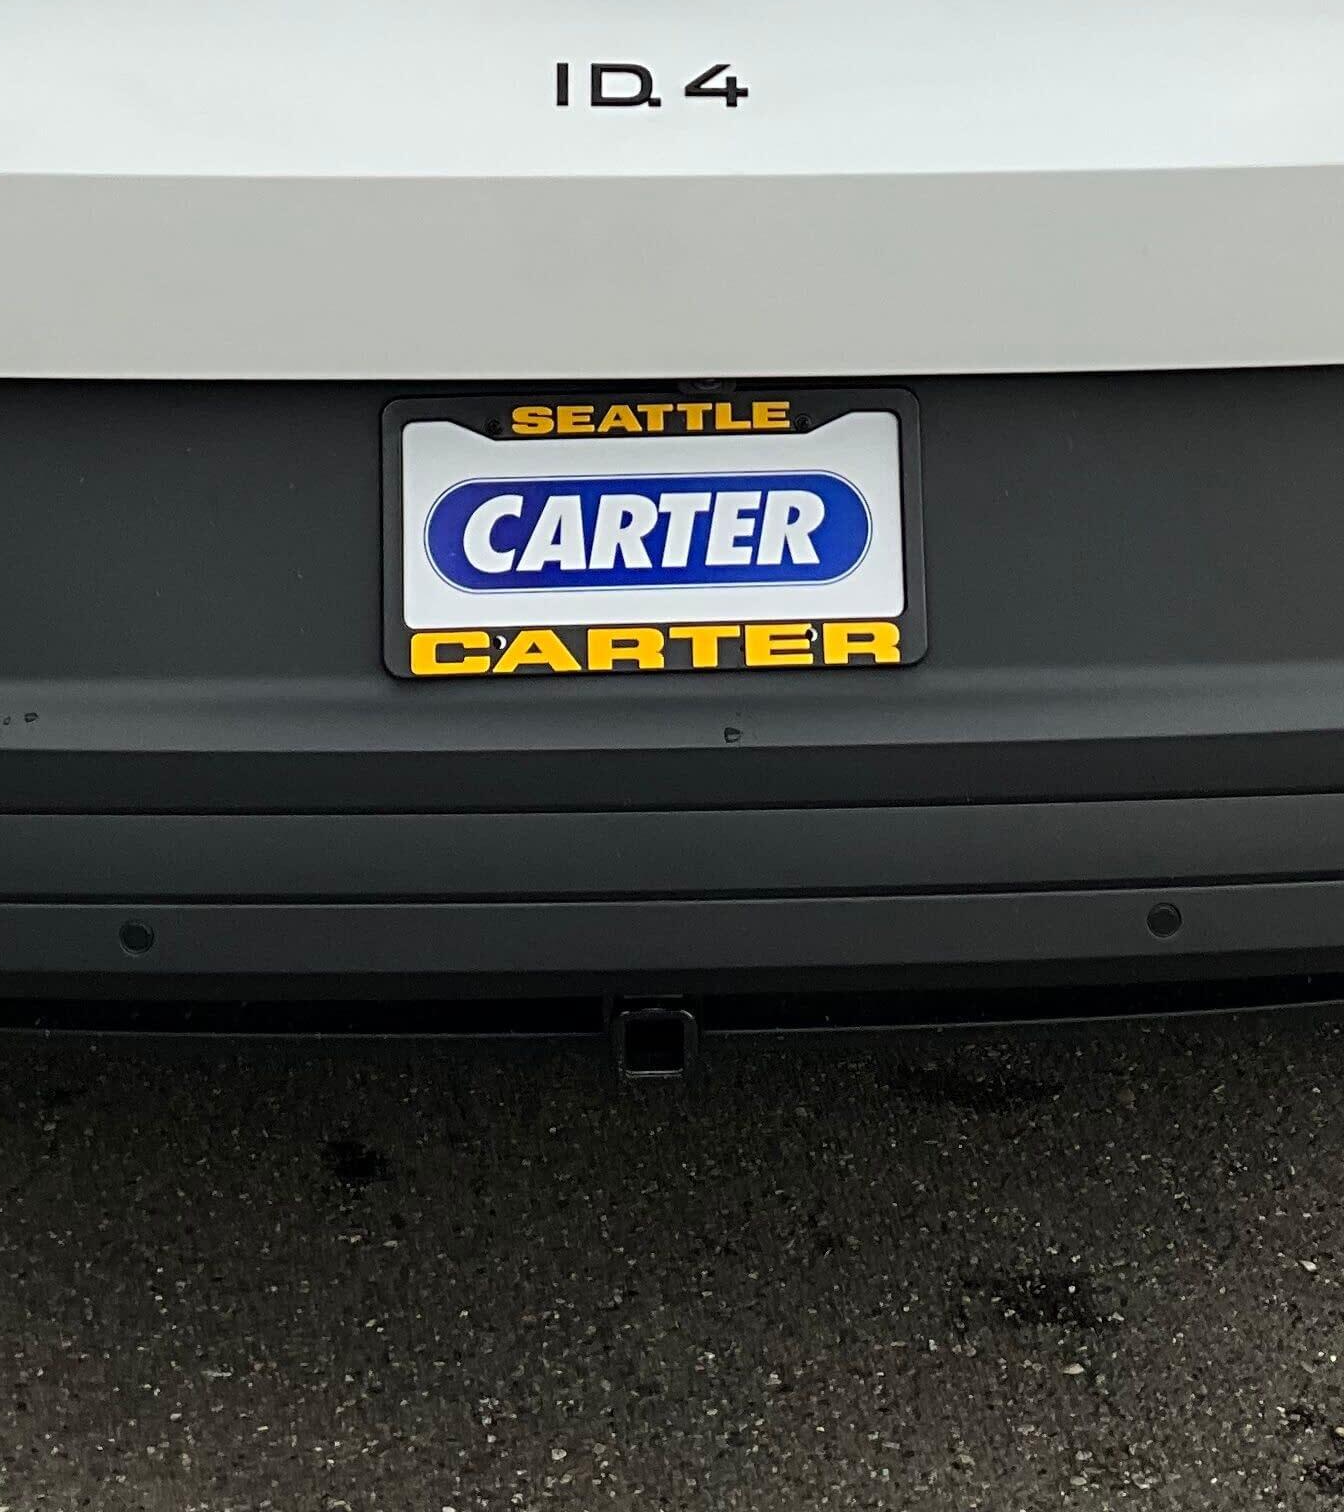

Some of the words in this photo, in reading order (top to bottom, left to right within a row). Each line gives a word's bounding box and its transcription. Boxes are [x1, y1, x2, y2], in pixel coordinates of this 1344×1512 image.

[511, 401, 791, 435] SEATTLE
[462, 490, 826, 574] CARTER
[409, 621, 902, 676] CARTER
